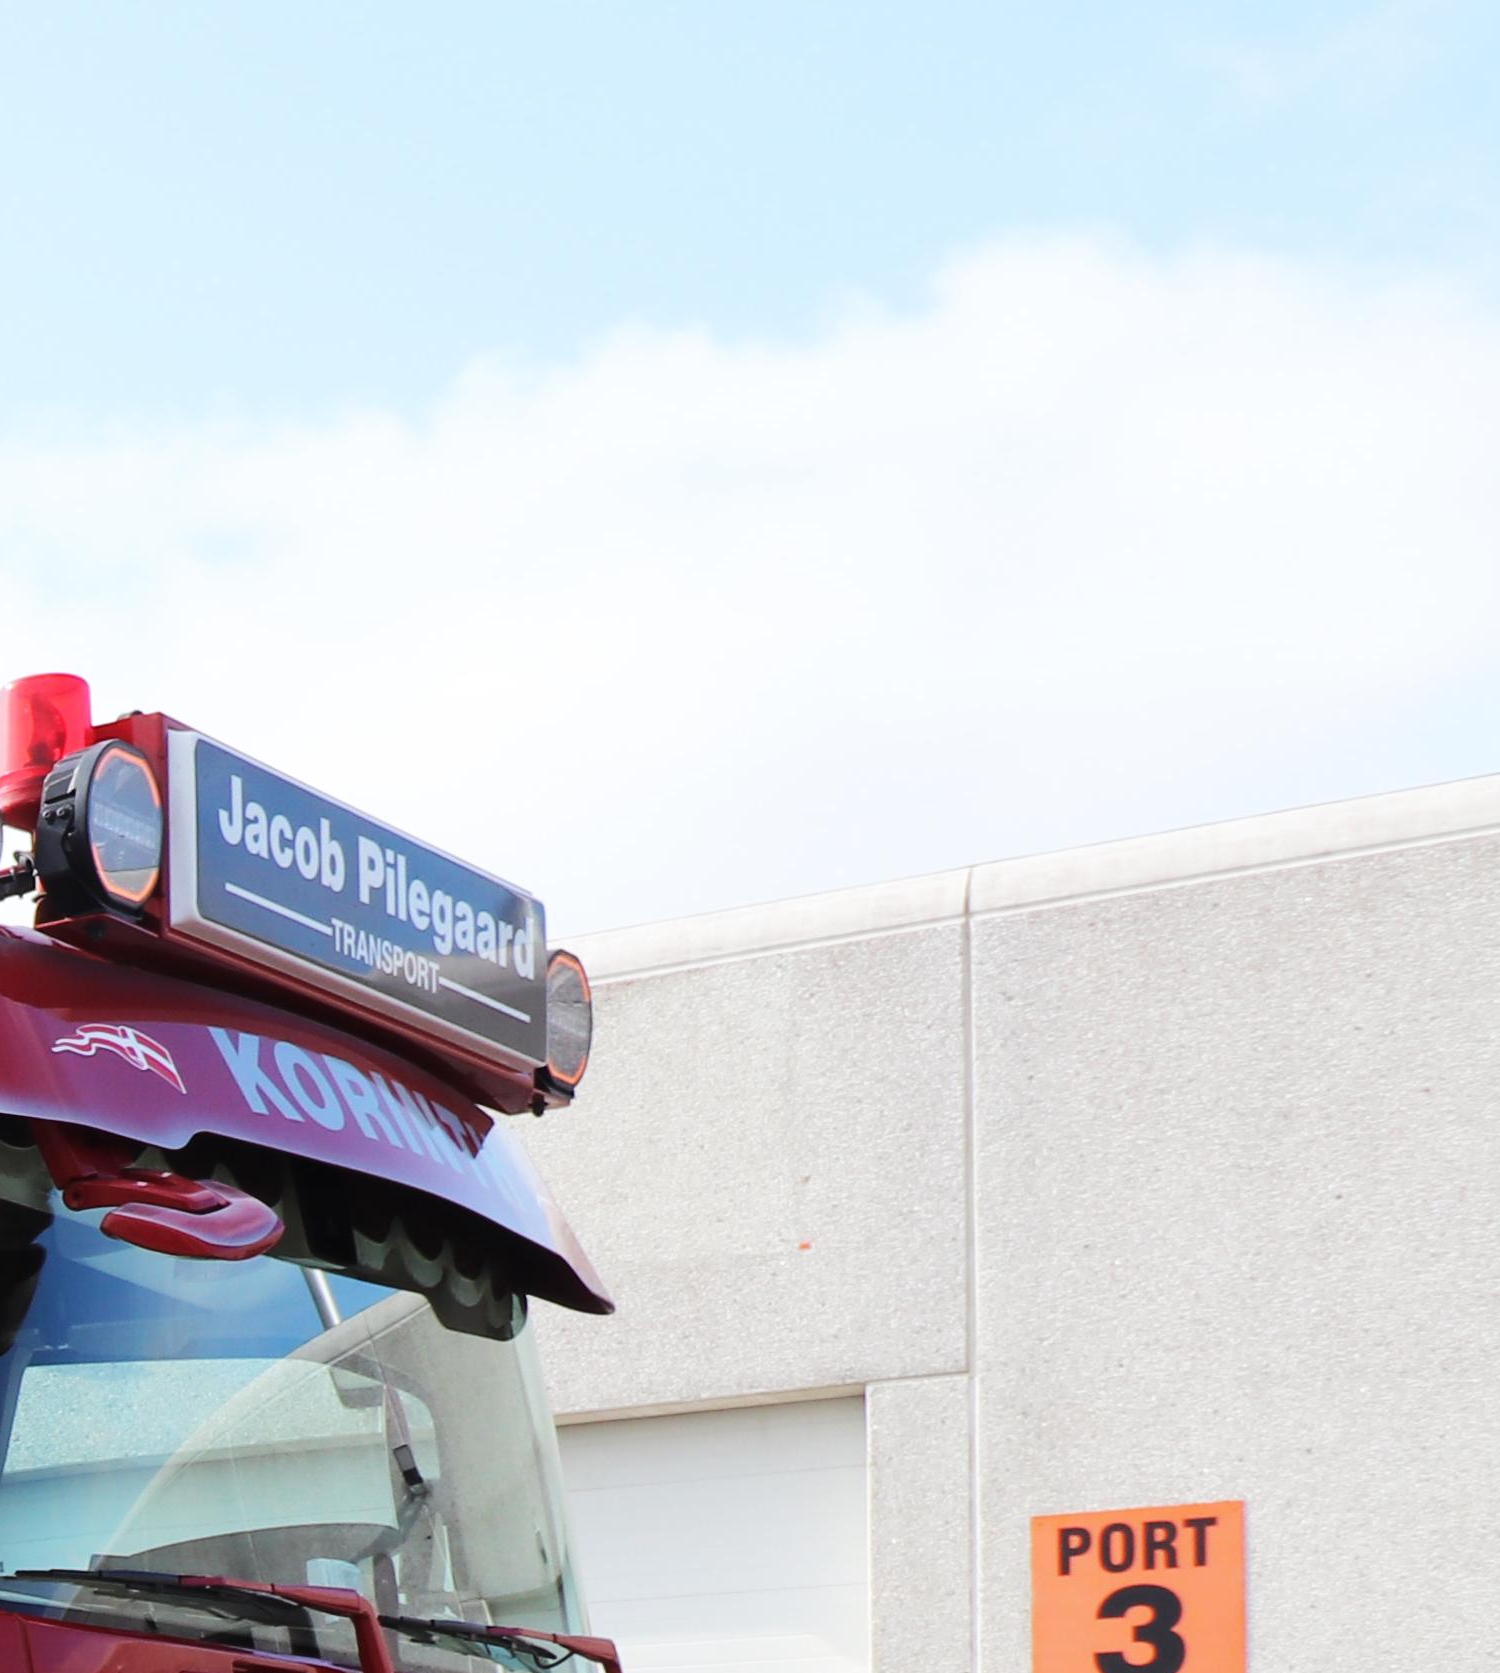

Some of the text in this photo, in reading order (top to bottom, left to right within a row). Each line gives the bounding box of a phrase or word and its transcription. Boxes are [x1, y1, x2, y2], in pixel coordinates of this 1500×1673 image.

[218, 776, 536, 981] Jacob Pilegaard
[331, 918, 440, 994] TRANSPORT
[1057, 1517, 1218, 1576] PORT
